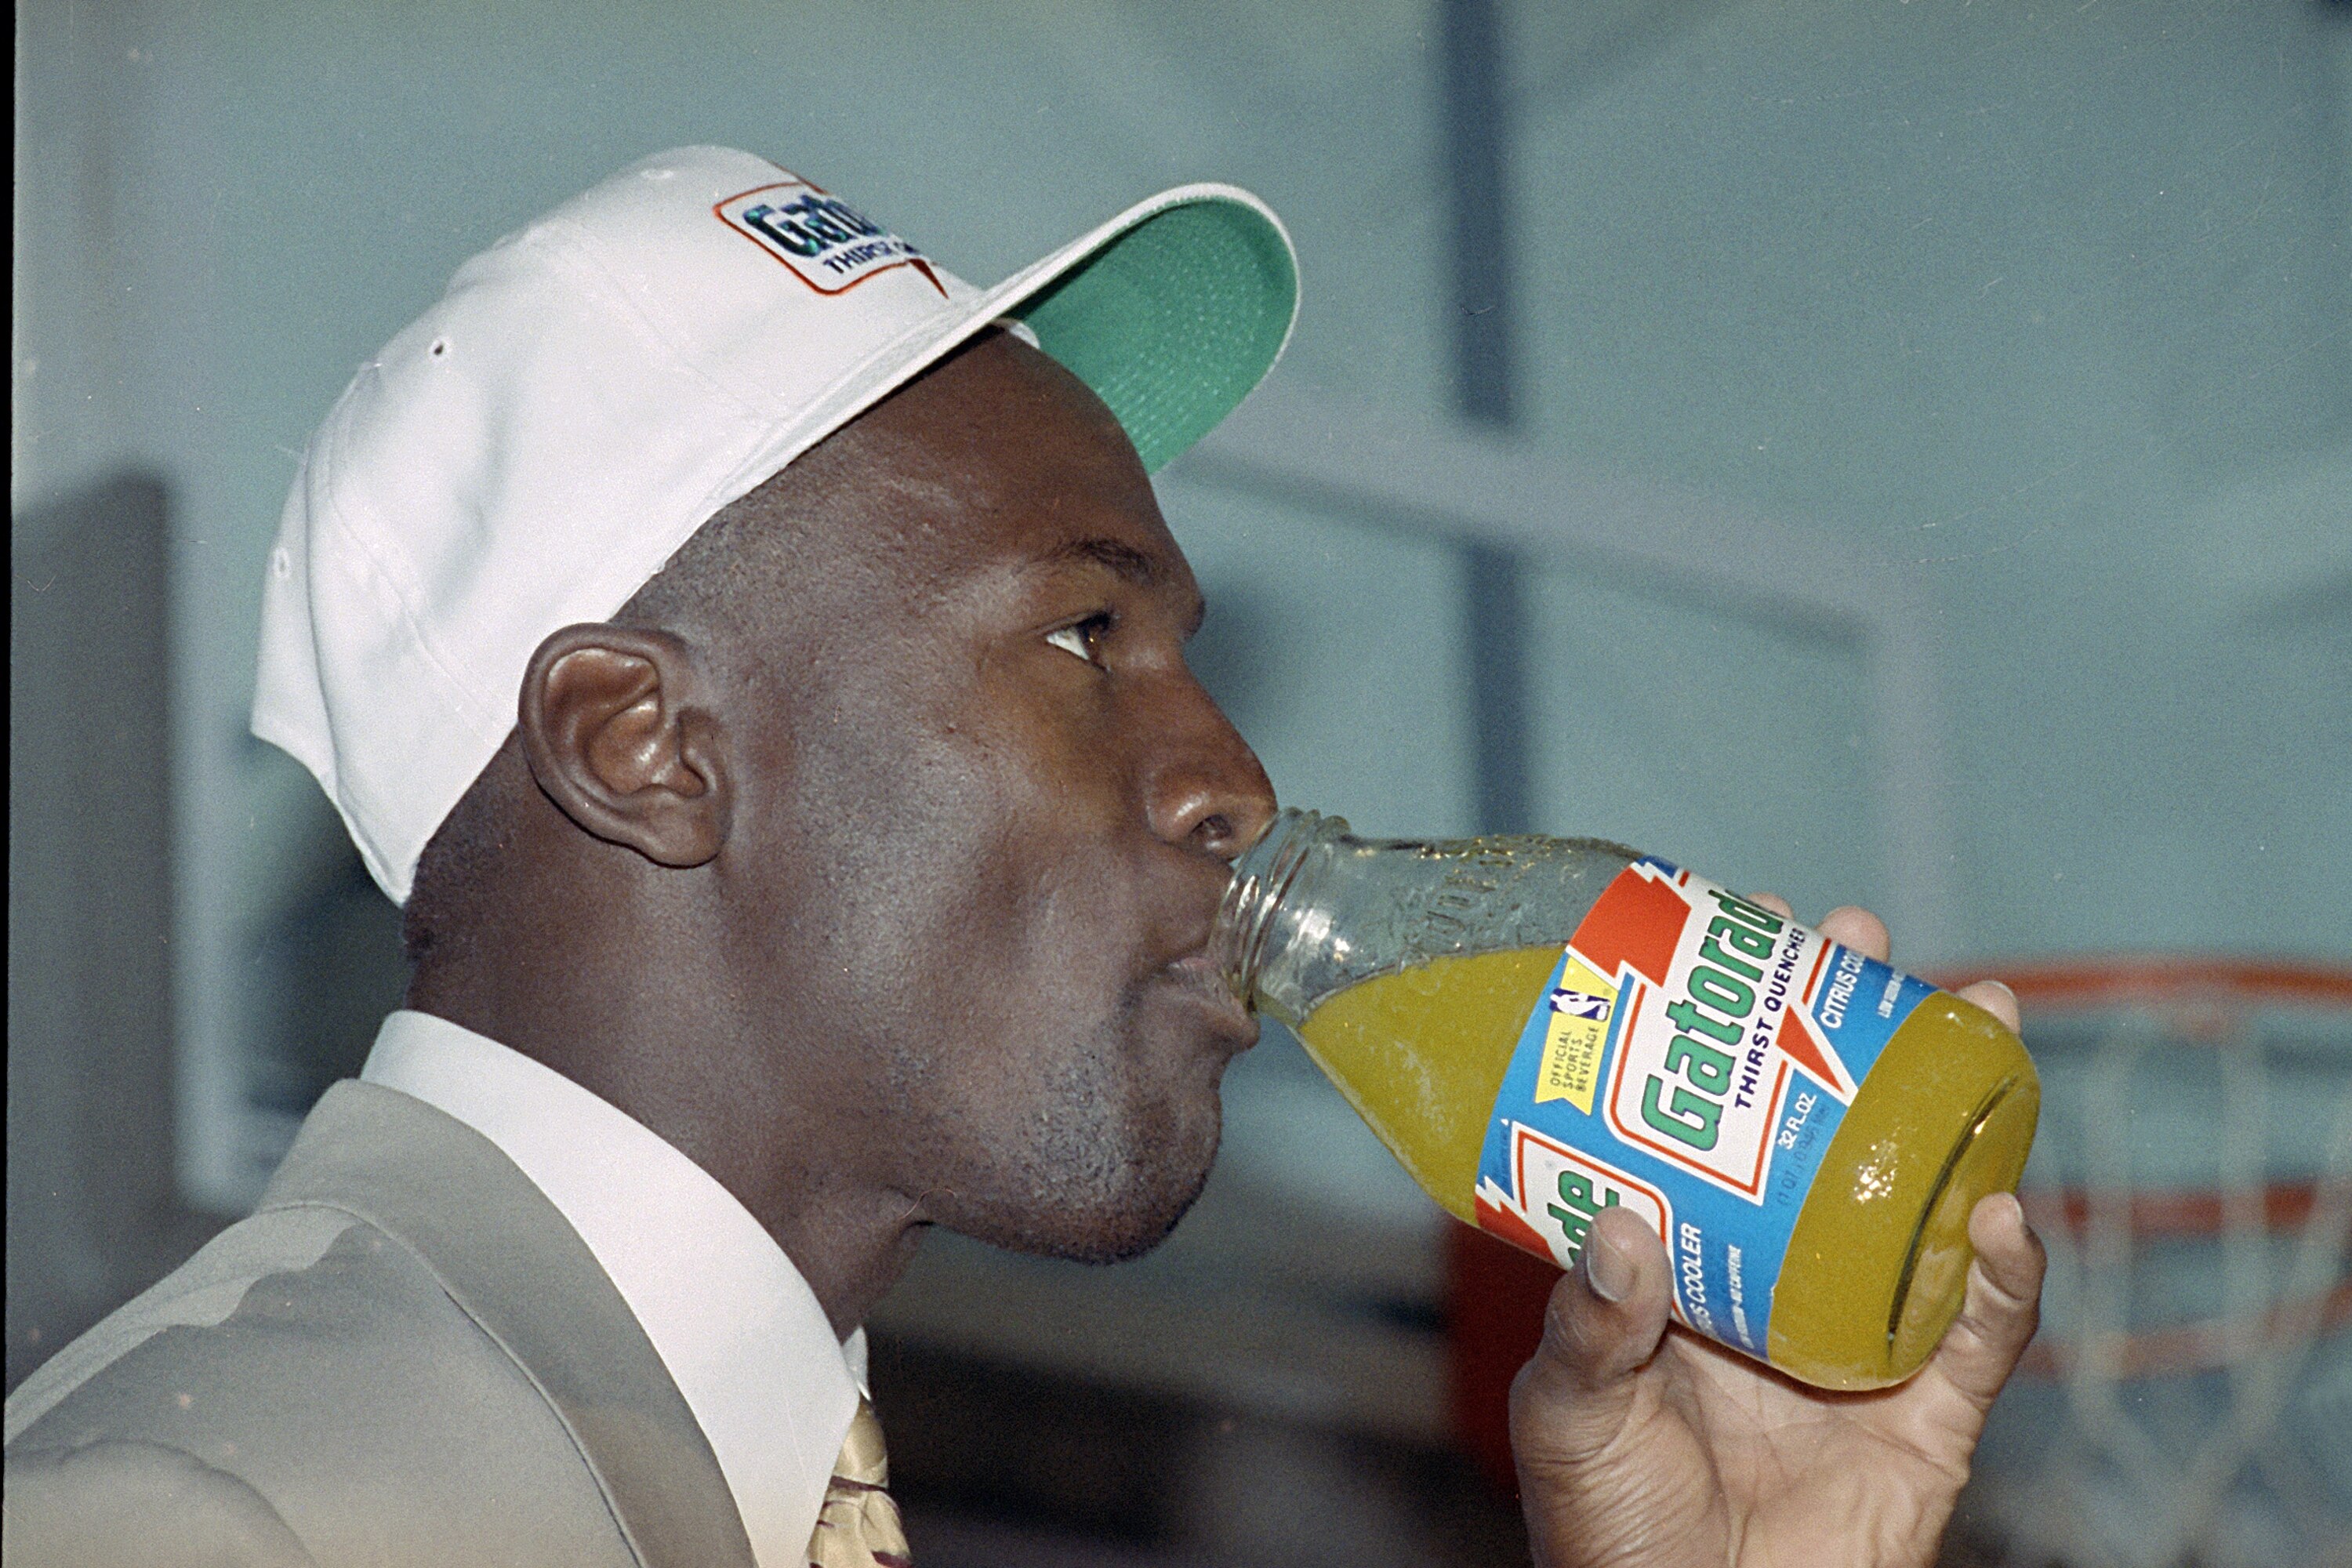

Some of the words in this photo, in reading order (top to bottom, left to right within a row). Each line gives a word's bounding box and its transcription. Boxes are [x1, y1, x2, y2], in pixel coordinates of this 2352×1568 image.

[1642, 887, 1784, 1152] Gatorad
[1820, 970, 1857, 1029] CITRUS
[1549, 1031, 1572, 1087] OFFICIAL
[1563, 1039, 1582, 1090] SPORTS
[1575, 1027, 1599, 1092] BEVERAGE
[1735, 1018, 1774, 1109] THIRST
[1777, 1129, 1798, 1149] 32
[1547, 1170, 1620, 1264] de
[1681, 1222, 1707, 1305] COOLER
